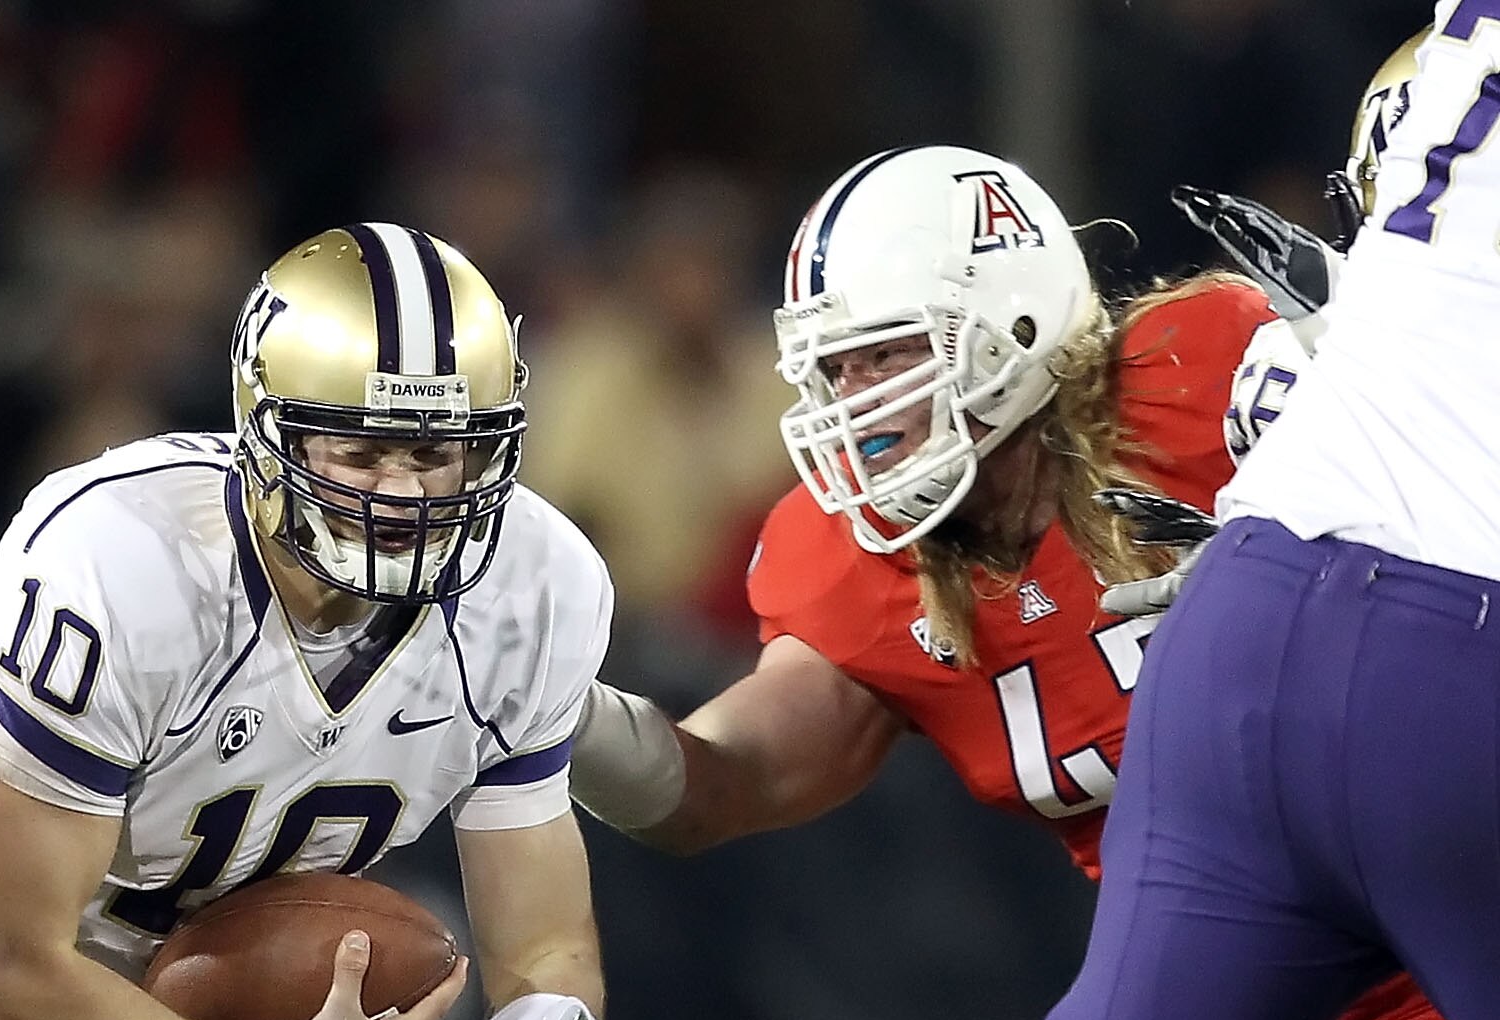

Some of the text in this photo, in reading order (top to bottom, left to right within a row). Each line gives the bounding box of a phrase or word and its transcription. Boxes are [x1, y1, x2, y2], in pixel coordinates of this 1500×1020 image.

[954, 171, 1045, 254] A
[391, 383, 446, 398] DAWGS
[992, 612, 1160, 820] 4
[100, 777, 408, 940] 10
